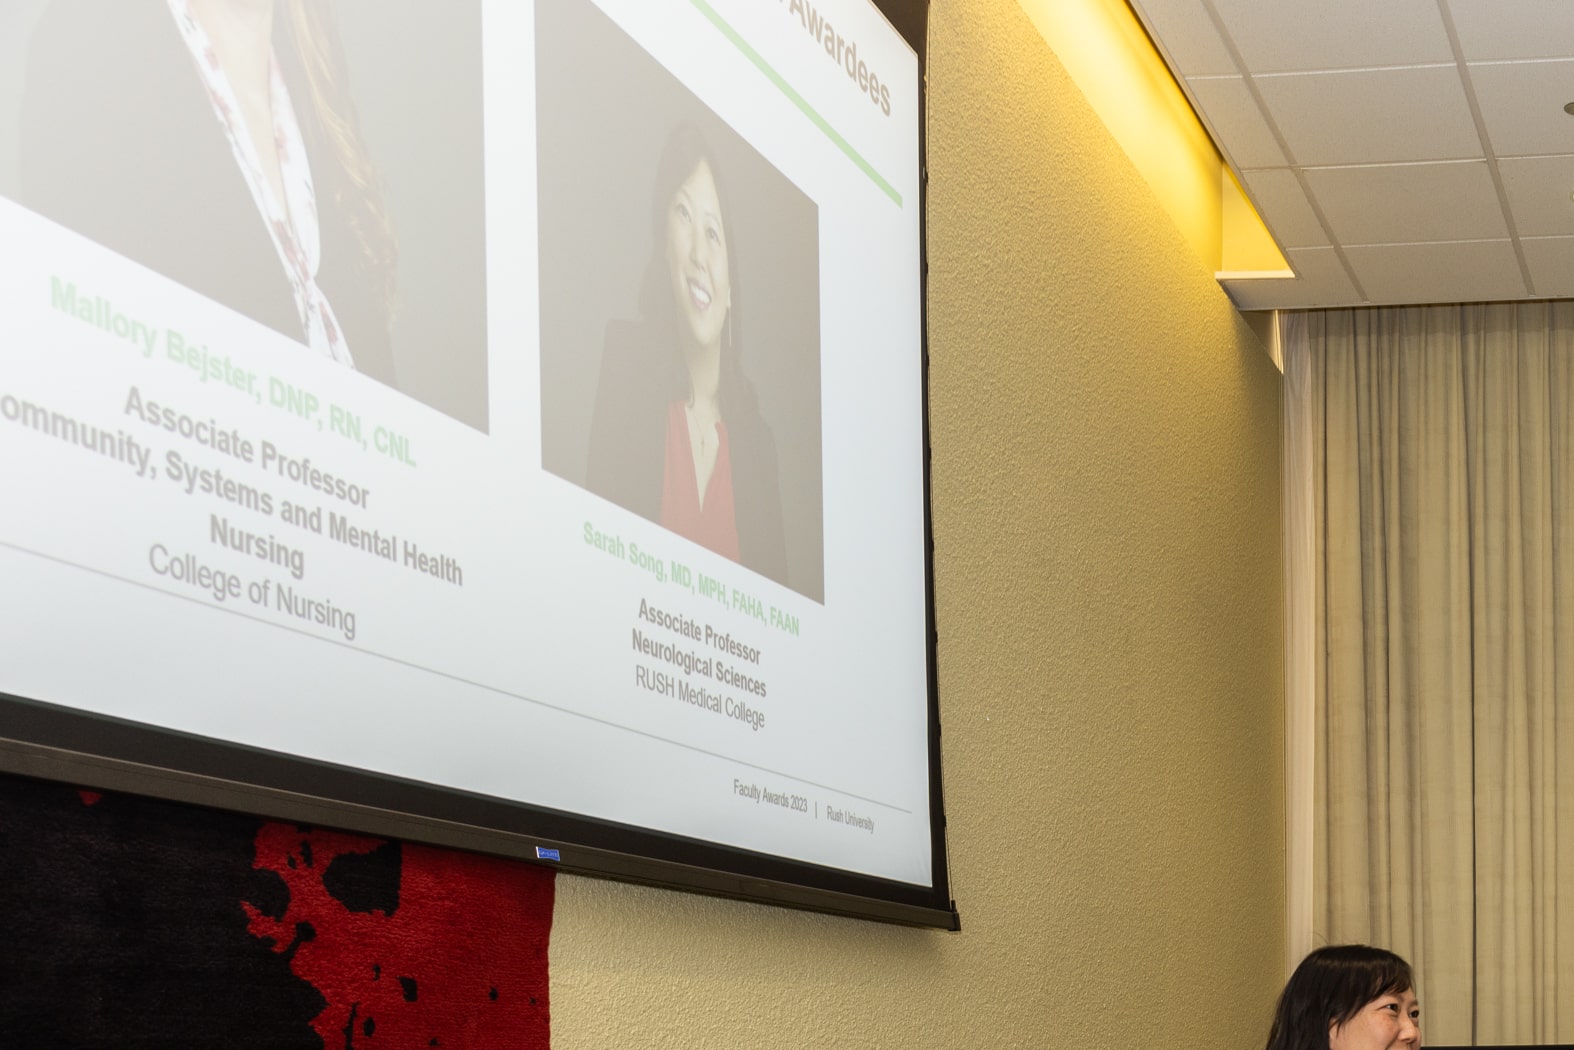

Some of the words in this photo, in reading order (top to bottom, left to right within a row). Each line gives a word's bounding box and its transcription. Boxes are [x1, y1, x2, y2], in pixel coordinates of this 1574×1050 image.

[789, 0, 891, 118] Awardees
[51, 275, 157, 358] Mallory
[166, 329, 262, 405] Bejster,
[269, 376, 324, 431] DNP,
[330, 404, 368, 450] RN,
[374, 425, 417, 467] CNL
[124, 386, 254, 463] Associate
[261, 440, 370, 509] Professor
[165, 449, 273, 515] Systems
[281, 503, 322, 535] and
[329, 512, 397, 562] Mental
[403, 540, 464, 587] Health
[210, 513, 305, 580] Nursing
[149, 543, 241, 601] College
[248, 579, 270, 607] of
[276, 583, 356, 641] Nursing
[583, 521, 626, 561] Sarah
[629, 542, 668, 584] Song,
[671, 561, 695, 595] MD,
[698, 573, 730, 610] MPH,
[732, 588, 767, 626] FAHA,
[770, 606, 800, 637] FAAN
[632, 628, 713, 678] Neurological
[715, 661, 767, 697] Sciences
[638, 598, 702, 641] Associate
[705, 624, 761, 665] Professor
[636, 664, 675, 698] RUSH
[678, 679, 722, 714] Medical
[725, 697, 765, 731] College
[733, 778, 761, 804] Faculty
[762, 787, 790, 808] Awards
[790, 795, 808, 813] 2023
[827, 805, 844, 823] Rush
[844, 810, 875, 834] University
